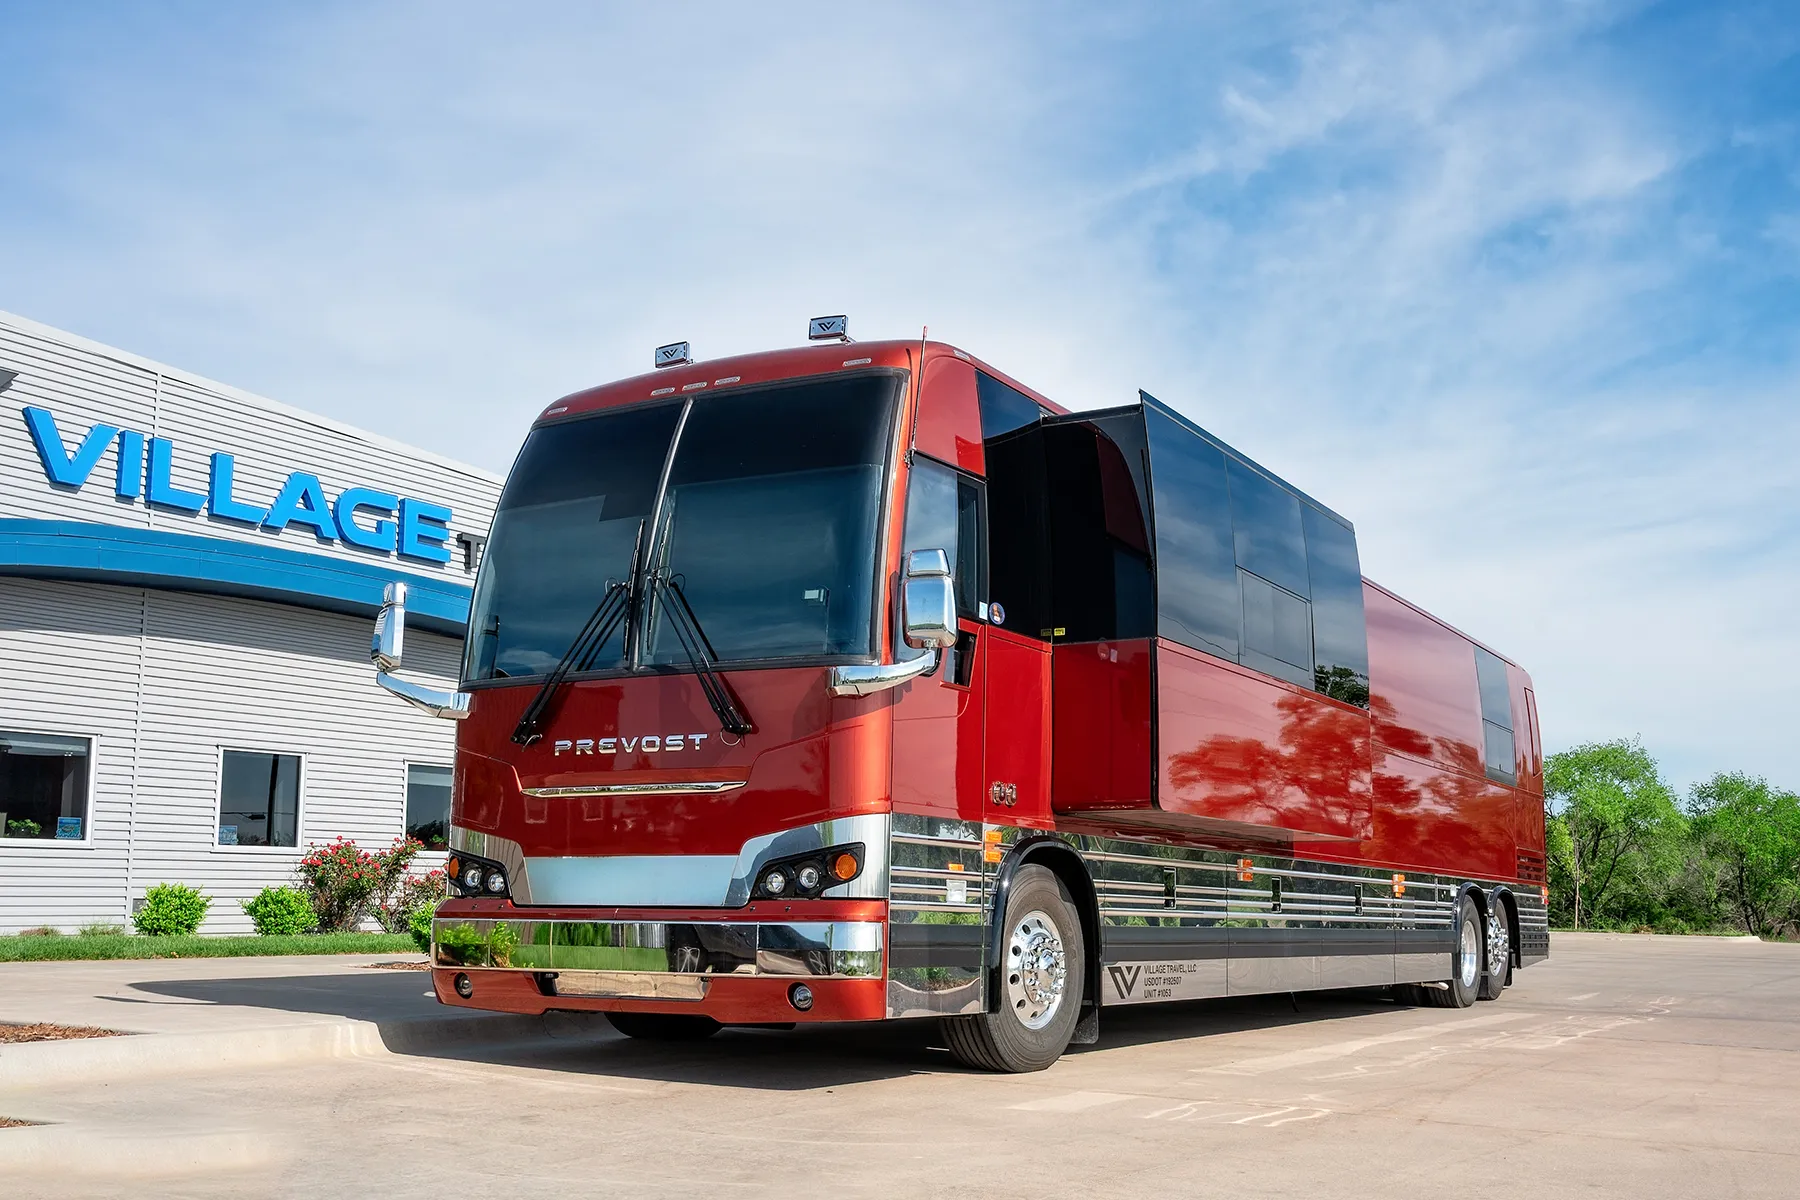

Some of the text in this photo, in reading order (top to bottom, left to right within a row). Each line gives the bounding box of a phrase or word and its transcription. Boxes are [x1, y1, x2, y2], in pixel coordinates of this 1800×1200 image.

[22, 406, 453, 564] VILLAGE
[554, 733, 708, 756] PREVOST
[1143, 964, 1197, 974] VILLAGE TRAVEL, LLC
[1143, 976, 1162, 986] USDOT
[1143, 989, 1157, 998] UNIT
